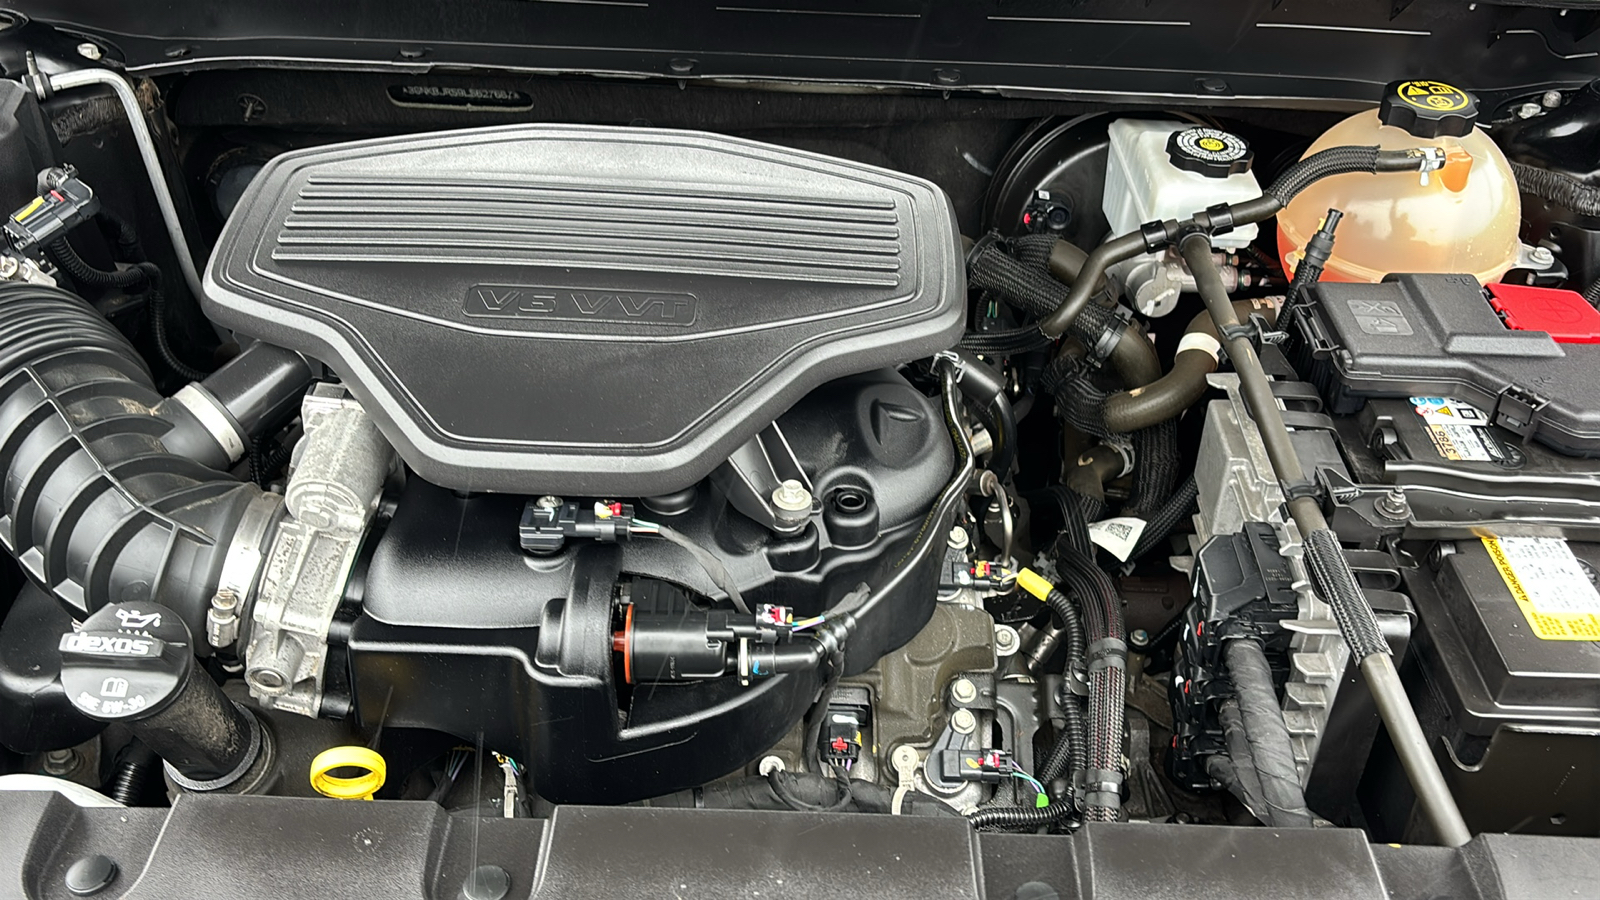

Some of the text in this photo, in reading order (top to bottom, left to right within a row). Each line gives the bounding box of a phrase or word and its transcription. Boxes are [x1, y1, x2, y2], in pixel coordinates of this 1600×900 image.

[477, 289, 689, 319] V6 VVT
[1502, 566, 1525, 595] DANGER
[66, 631, 150, 655] dexos
